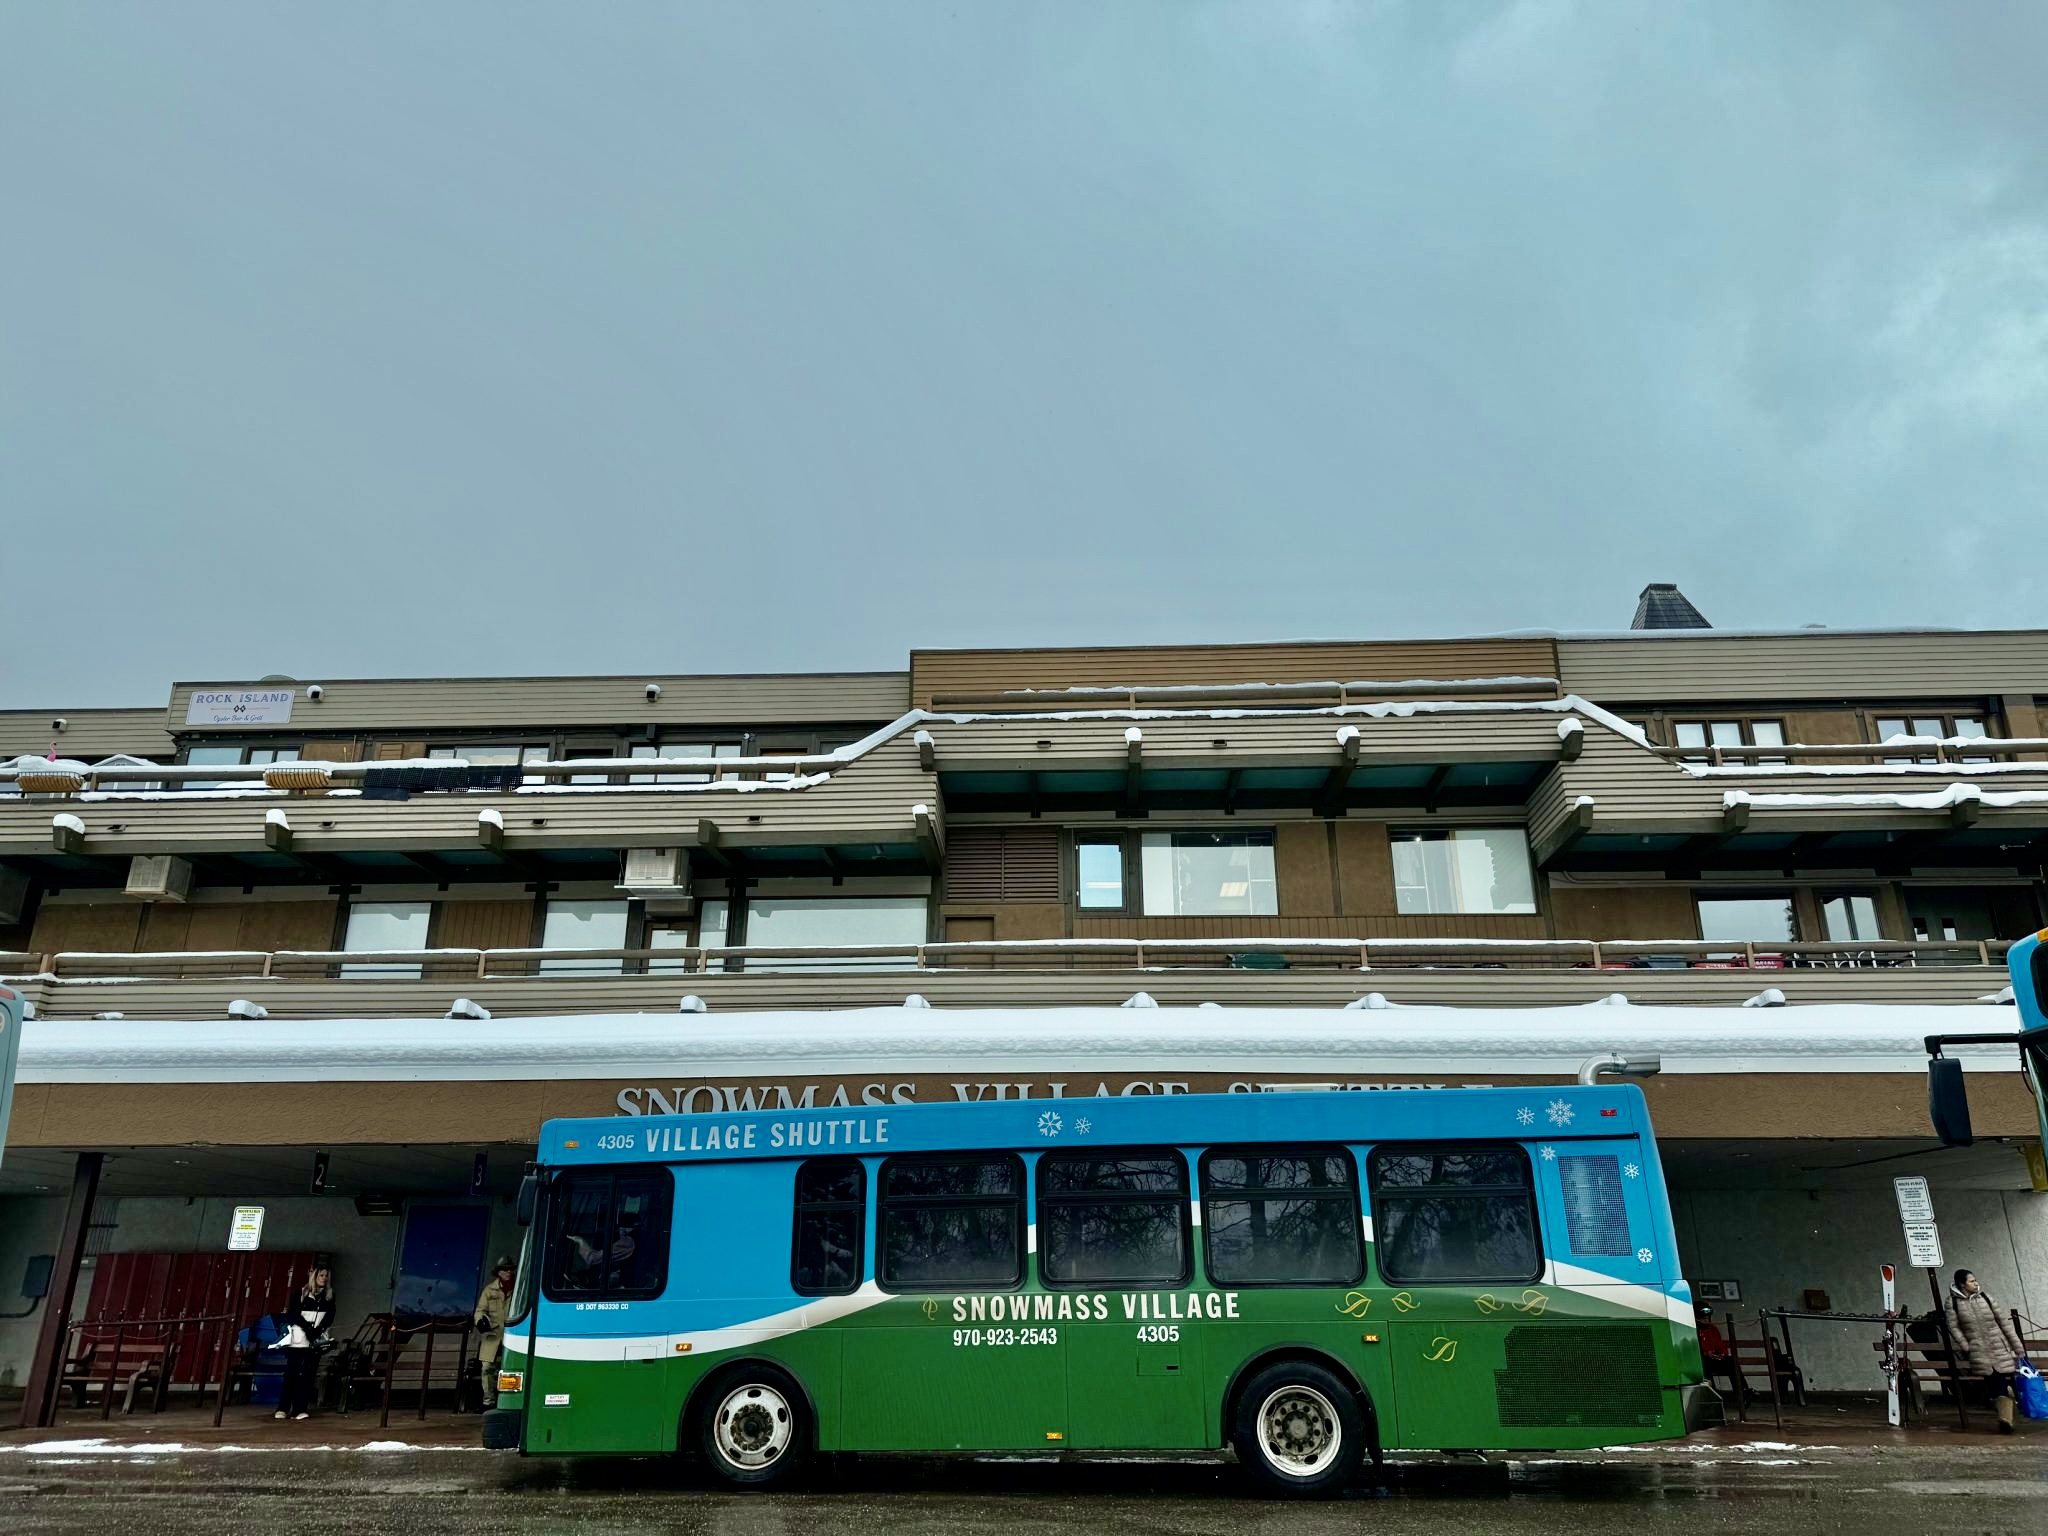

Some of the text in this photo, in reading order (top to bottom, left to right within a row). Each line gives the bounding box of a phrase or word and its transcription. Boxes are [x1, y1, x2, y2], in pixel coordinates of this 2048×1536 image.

[196, 693, 289, 703] ROCK ISLAND
[597, 1118, 889, 1153] 4305 VILLAGE SHUTTLE
[315, 1163, 325, 1186] 2
[475, 1164, 483, 1187] 3
[953, 1292, 1240, 1321] SNOWMASS VILLAGE
[953, 1328, 1058, 1347] 970-923-2543
[1136, 1325, 1180, 1343] 4305
